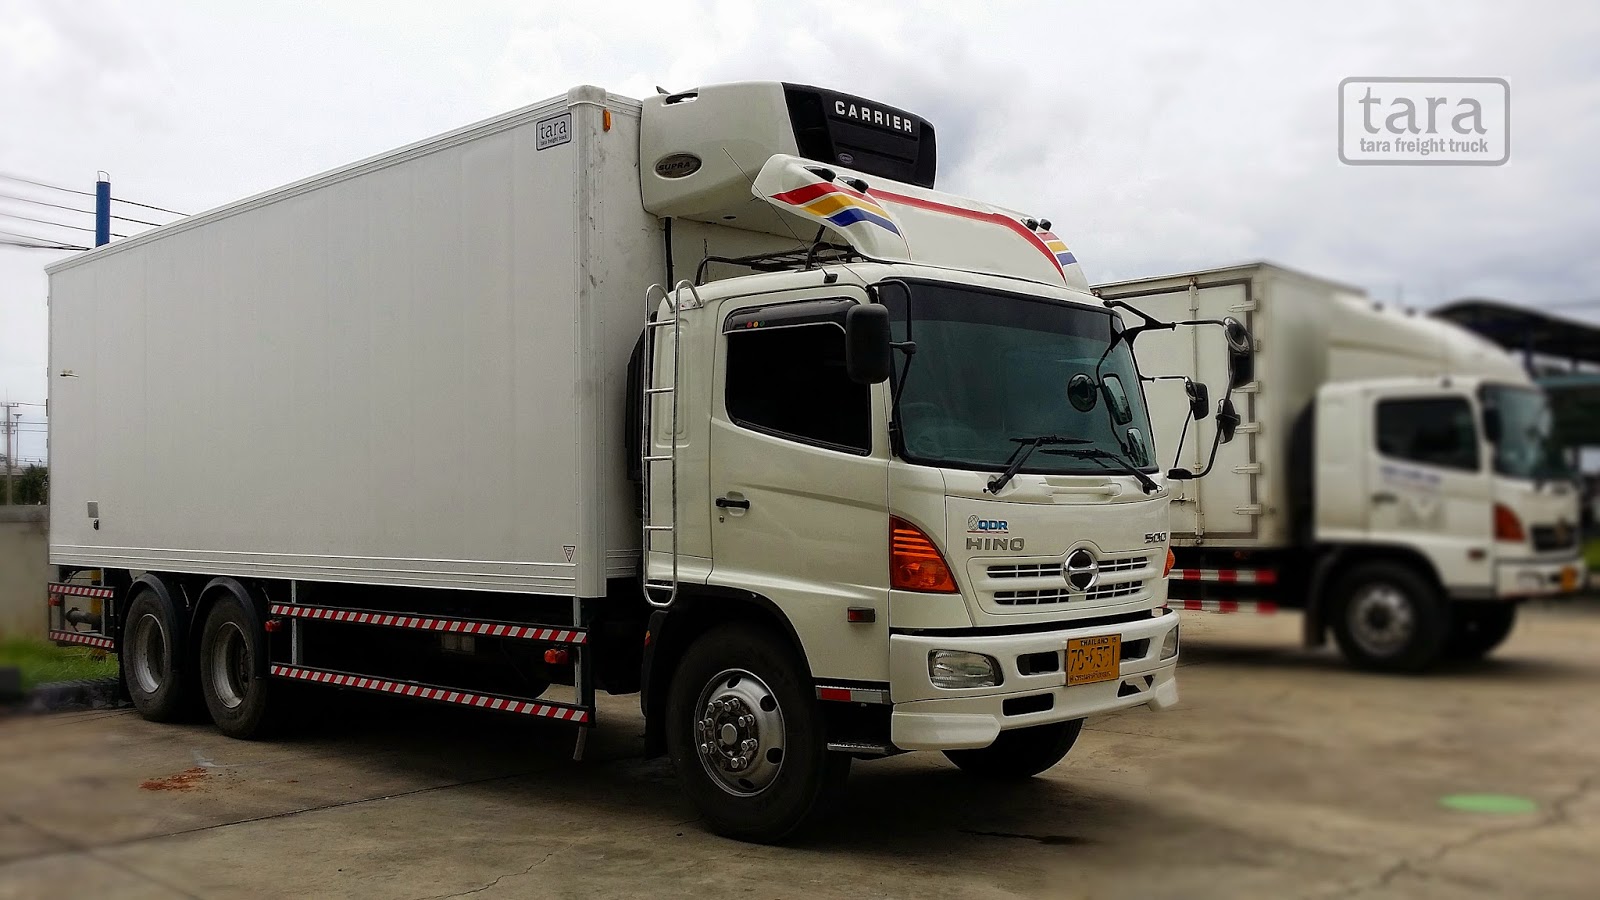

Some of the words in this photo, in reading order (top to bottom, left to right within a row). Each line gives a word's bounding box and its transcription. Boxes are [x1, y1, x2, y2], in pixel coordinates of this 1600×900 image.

[835, 100, 912, 133] CARRIER
[540, 121, 567, 139] tara
[658, 161, 691, 171] SUPRA
[977, 520, 1009, 531] QDR
[1144, 532, 1167, 544] 500
[966, 537, 1025, 552] HINO
[1080, 637, 1109, 647] THAILAND
